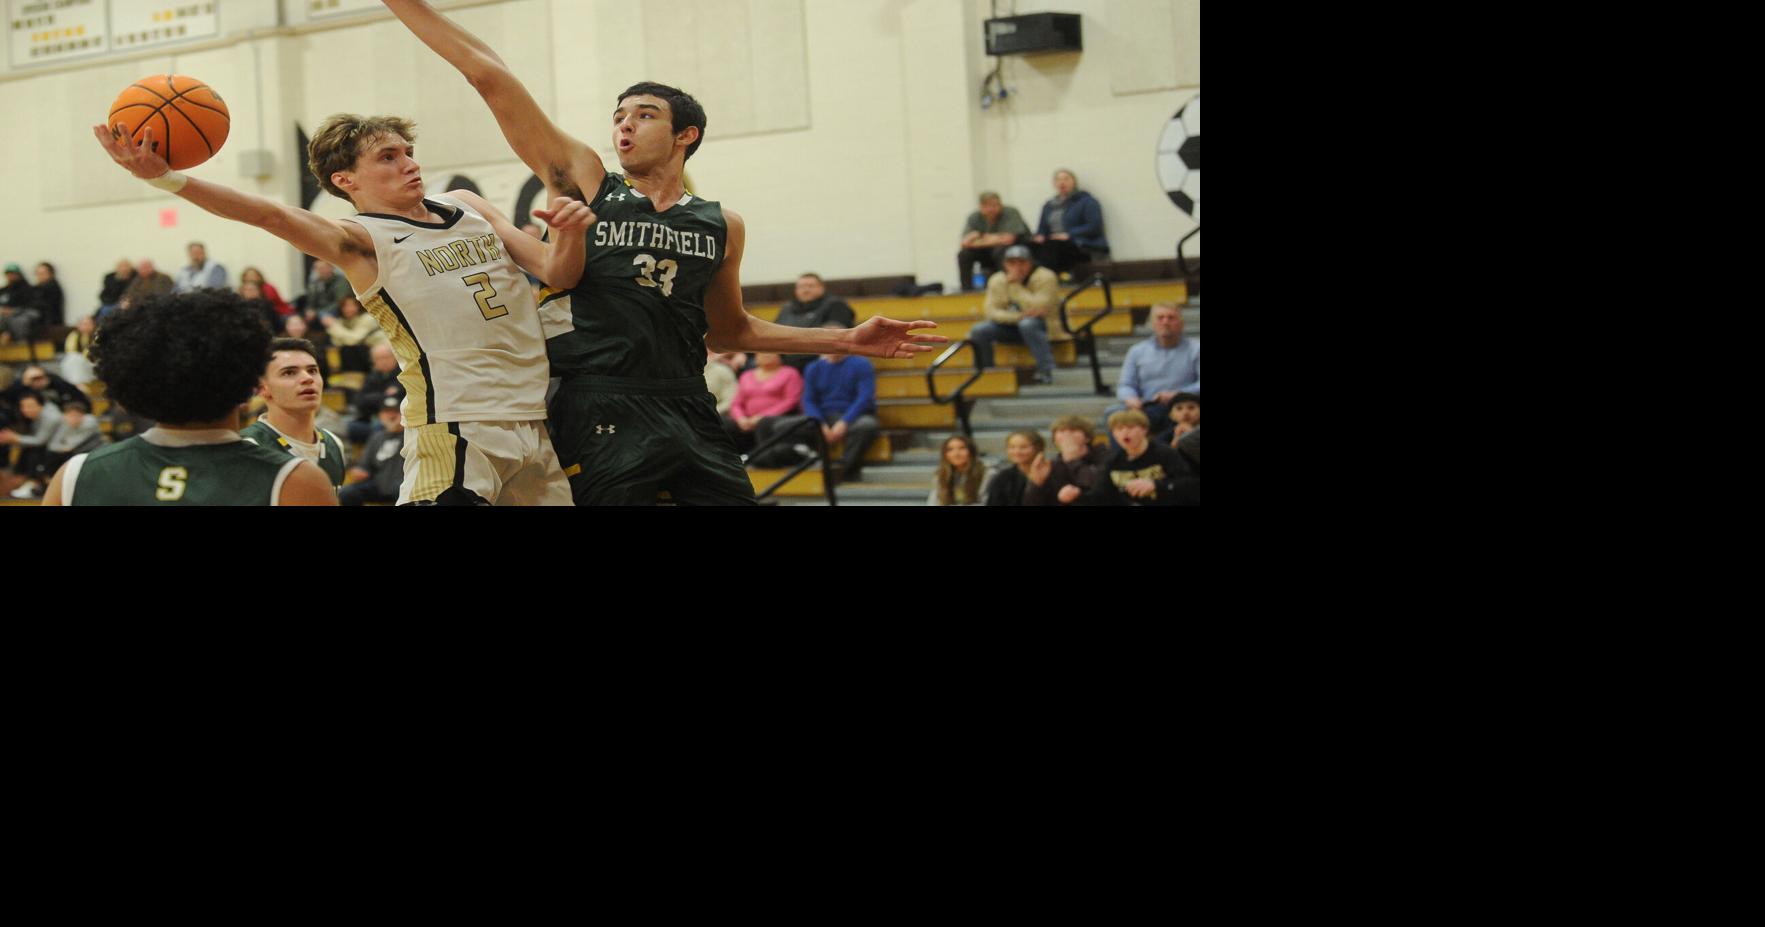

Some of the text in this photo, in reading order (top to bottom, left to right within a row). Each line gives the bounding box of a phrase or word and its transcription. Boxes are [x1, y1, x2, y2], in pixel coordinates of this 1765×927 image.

[415, 233, 502, 277] NORTH
[594, 220, 717, 261] SMITHFIELD
[462, 271, 509, 321] 2
[632, 253, 679, 298] 33
[155, 465, 189, 501] S
